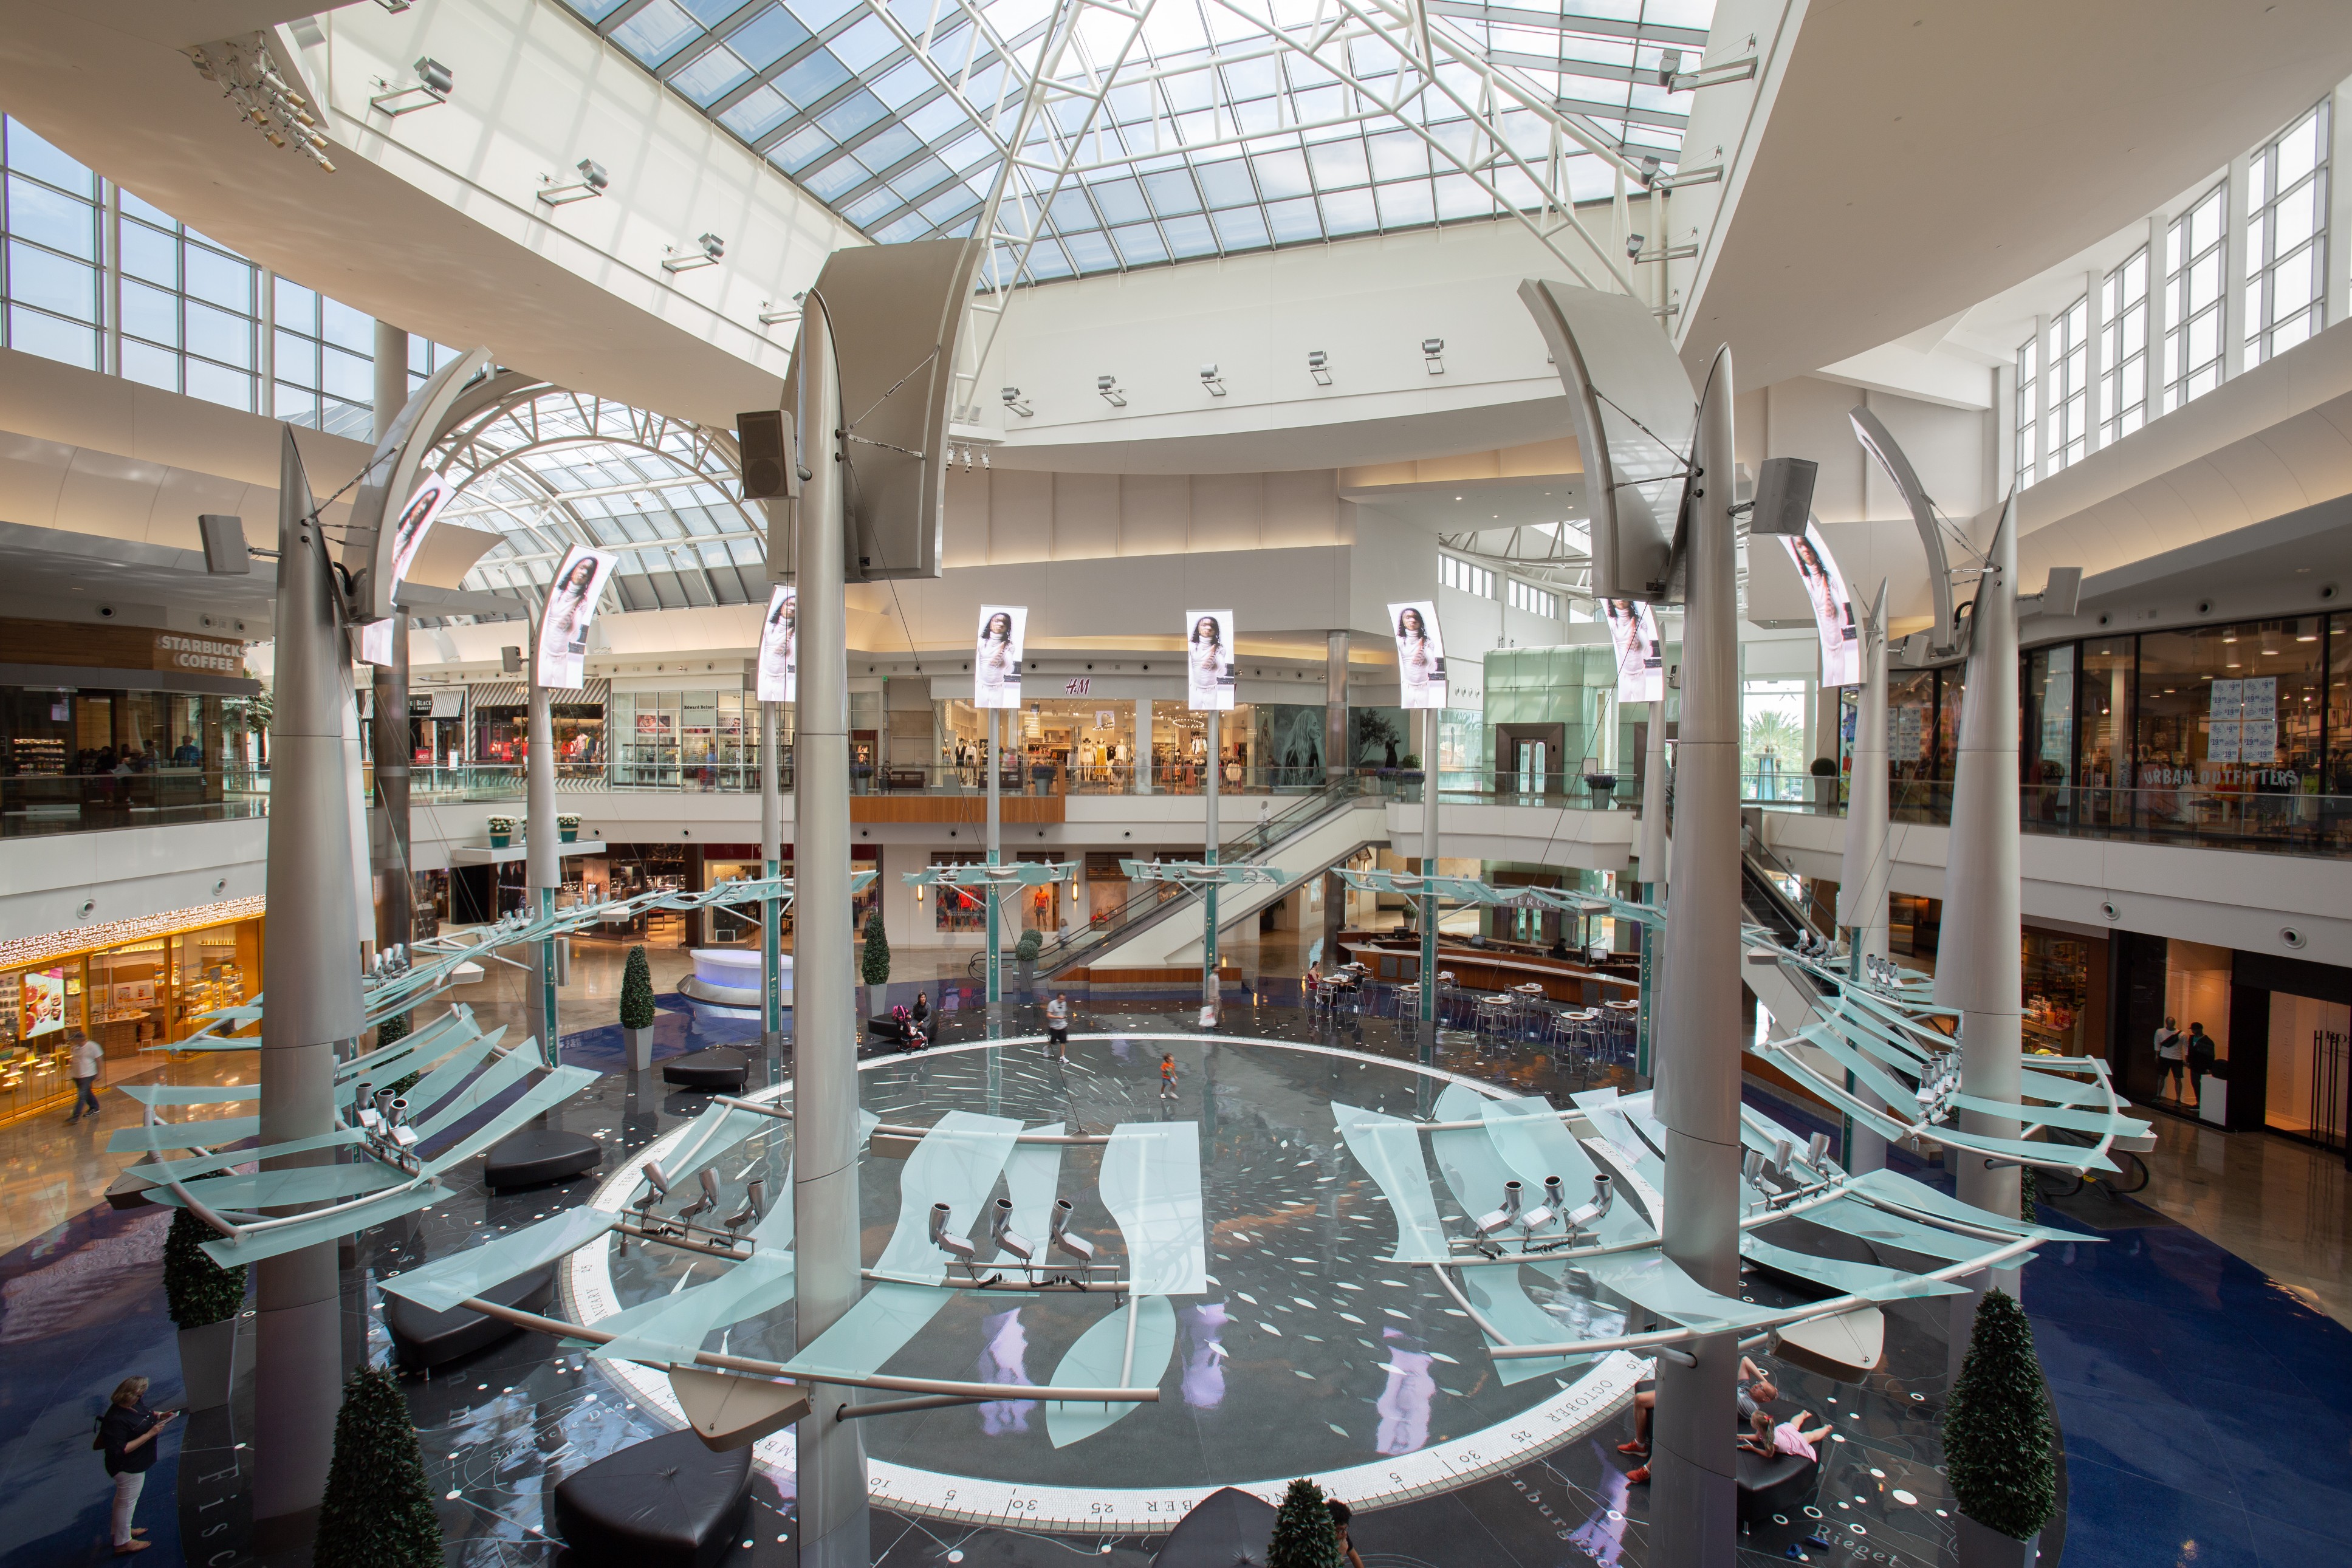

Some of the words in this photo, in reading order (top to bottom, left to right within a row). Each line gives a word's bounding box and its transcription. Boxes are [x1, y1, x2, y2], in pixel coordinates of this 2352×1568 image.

[162, 635, 248, 658] STARBUCKS
[180, 653, 234, 671] COFFEE
[1065, 678, 1090, 695] H&M
[2143, 767, 2193, 786] URBAN
[2199, 768, 2299, 787] OUTFITTERS
[1545, 1379, 1613, 1422] OCTOBER
[1510, 1429, 1532, 1443] 25
[1459, 1450, 1481, 1463] 30
[870, 1477, 892, 1488] 10
[1389, 1472, 1402, 1484] 5
[945, 1489, 957, 1501] 5
[1012, 1499, 1038, 1511] 30
[1091, 1502, 1114, 1515] 25
